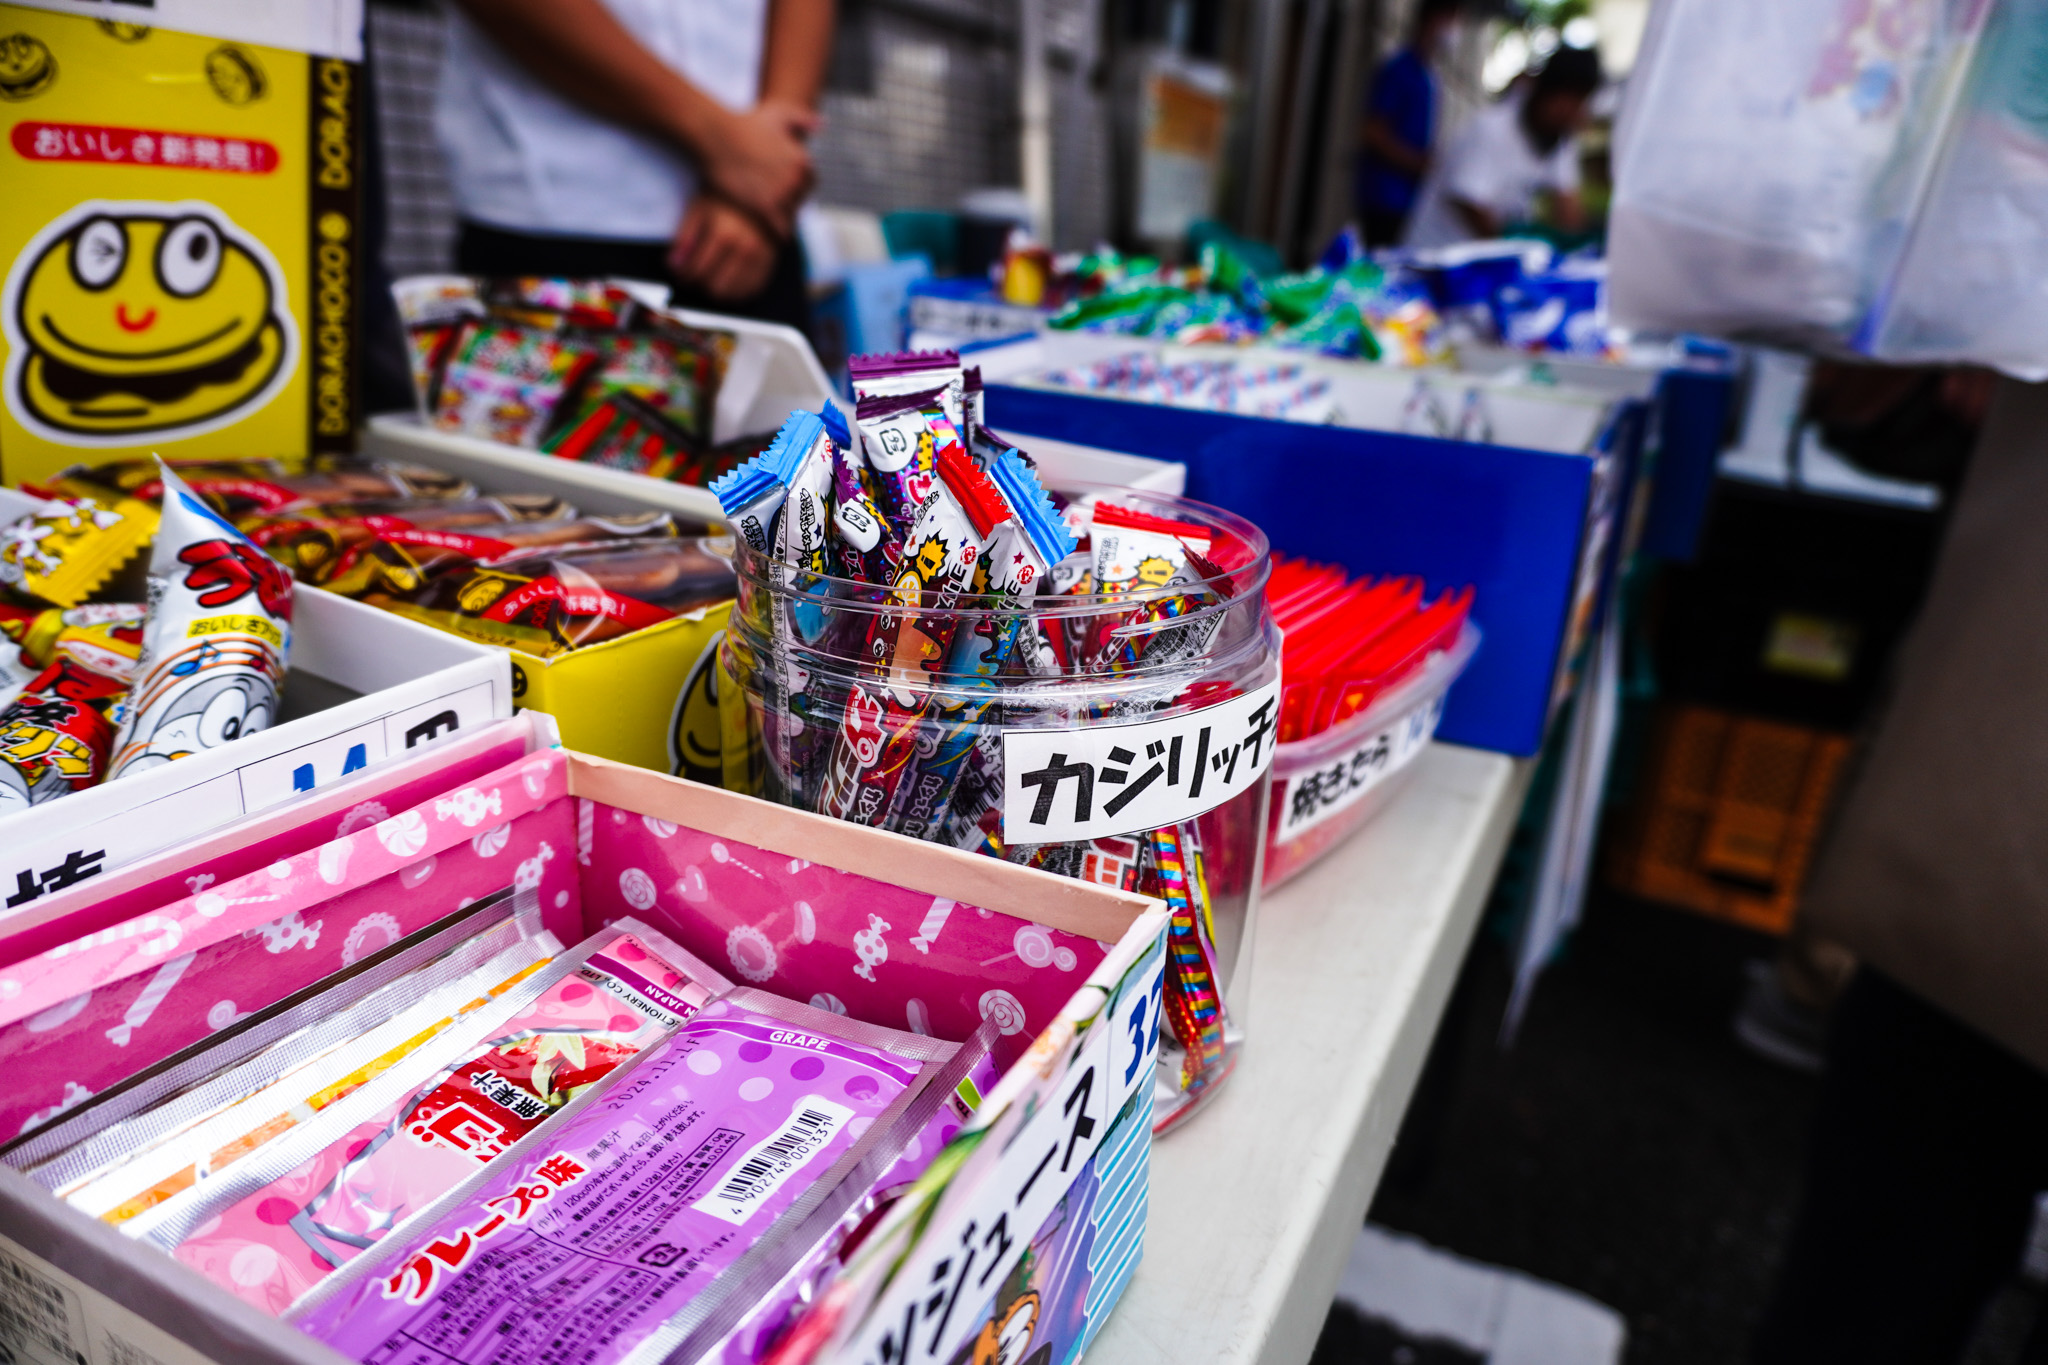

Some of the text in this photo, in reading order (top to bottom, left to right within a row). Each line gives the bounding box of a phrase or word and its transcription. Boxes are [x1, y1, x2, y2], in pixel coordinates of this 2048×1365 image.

[34, 126, 266, 173] おいしさ新発見!
[318, 243, 351, 437] DORACHOCO
[644, 984, 685, 1011] JAPAN
[769, 1030, 831, 1051] GRAPE
[470, 1070, 547, 1119] 無果汁
[410, 1103, 516, 1163] ゴ
[586, 1129, 622, 1161] 無果汁
[386, 1152, 588, 1302] グレープ味
